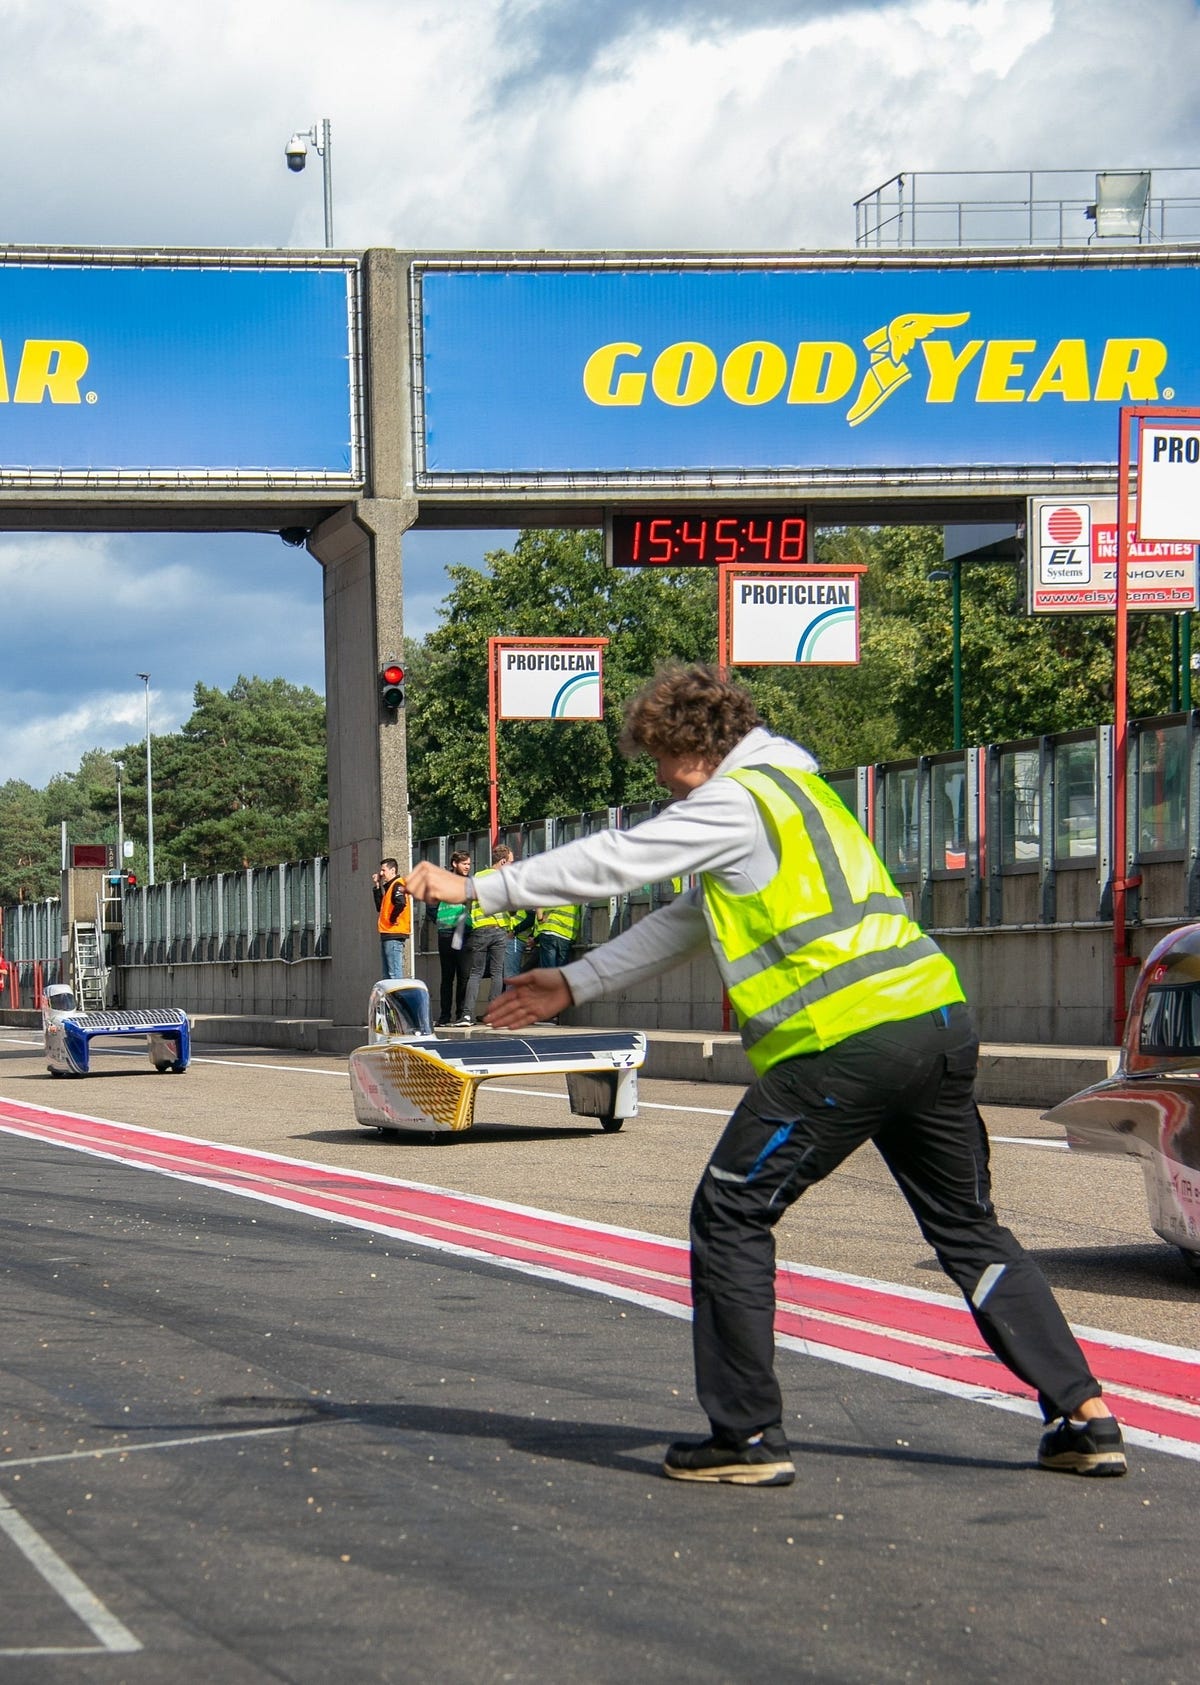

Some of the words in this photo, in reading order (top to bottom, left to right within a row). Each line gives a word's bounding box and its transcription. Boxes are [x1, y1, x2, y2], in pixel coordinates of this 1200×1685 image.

[632, 518, 805, 562] 15:45:48
[1048, 549, 1082, 565] EL
[1098, 543, 1192, 557] INSALLATIES
[1047, 568, 1083, 579] Systems
[741, 584, 850, 605] PROFICLEAN
[1039, 589, 1190, 602] www.elsytems.be
[507, 654, 595, 671] PROFICLEAN
